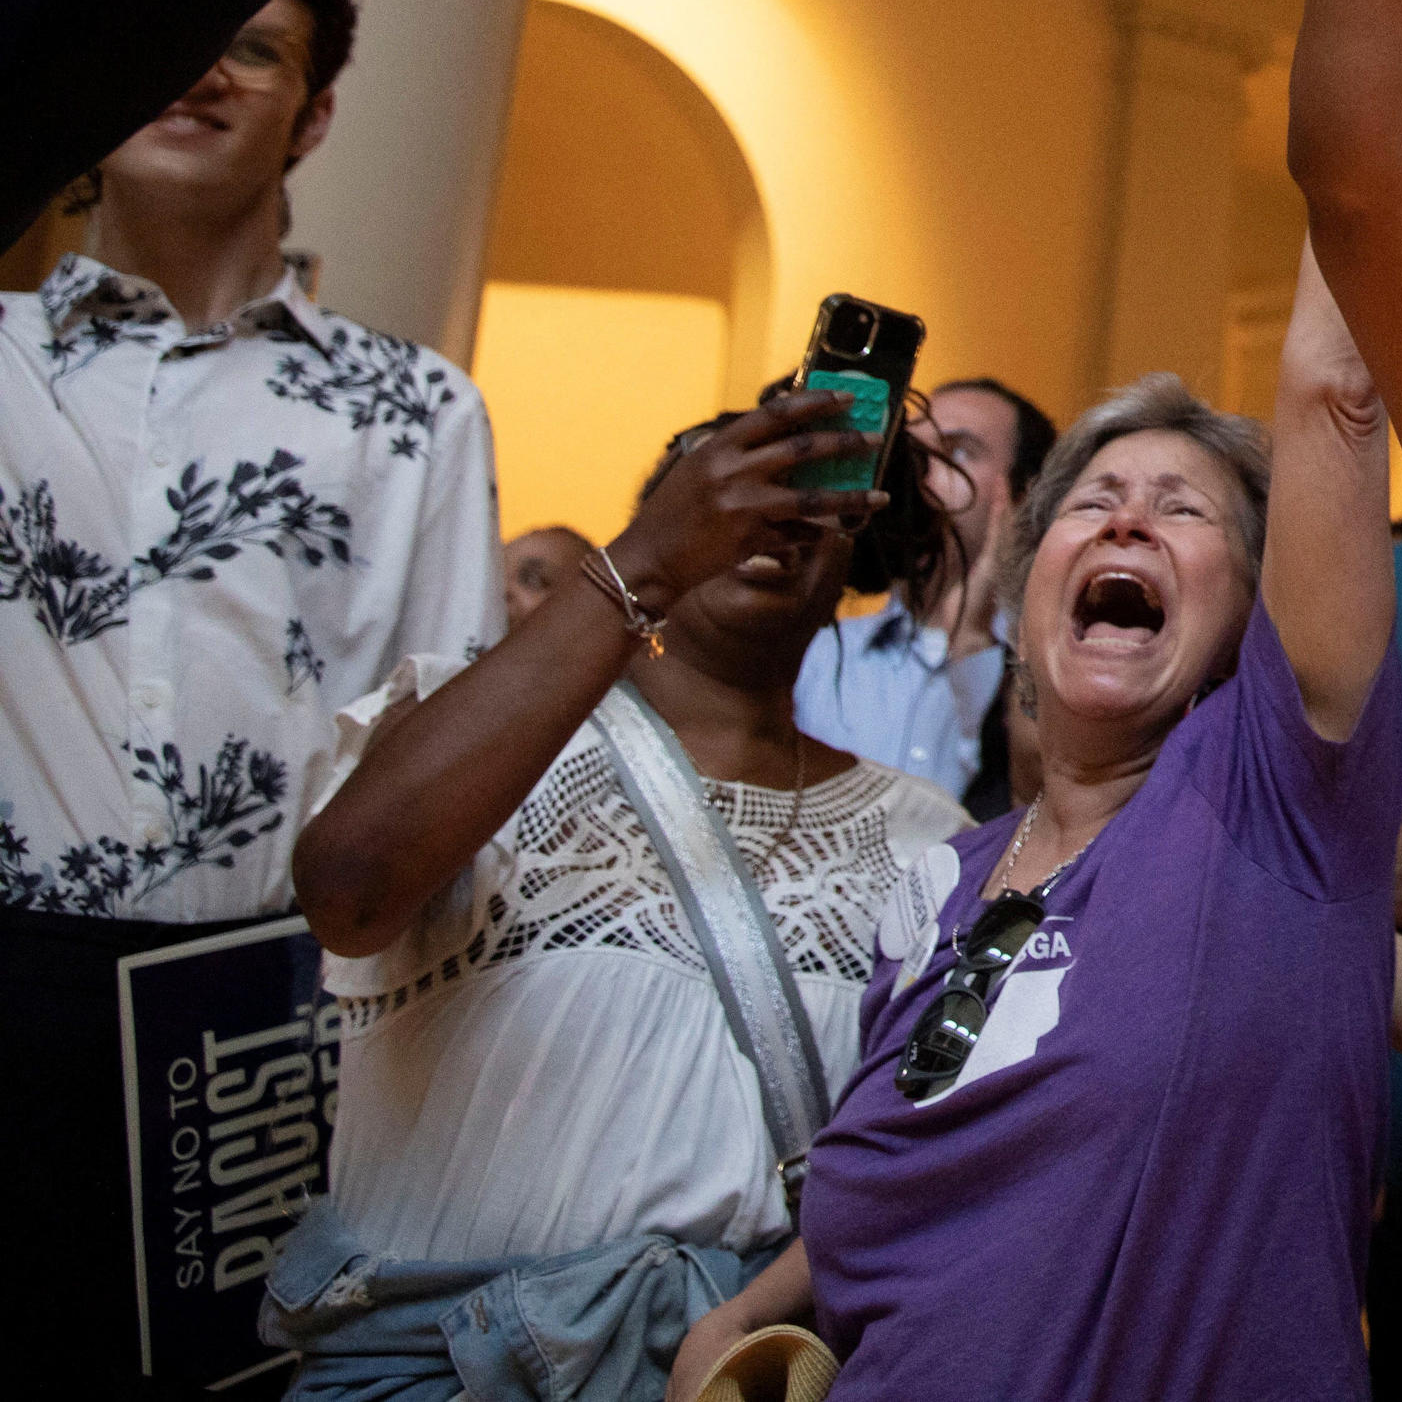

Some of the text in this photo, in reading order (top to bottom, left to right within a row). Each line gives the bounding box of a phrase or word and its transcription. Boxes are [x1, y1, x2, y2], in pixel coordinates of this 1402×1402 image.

[166, 1056, 203, 1289] SAY NO TO
